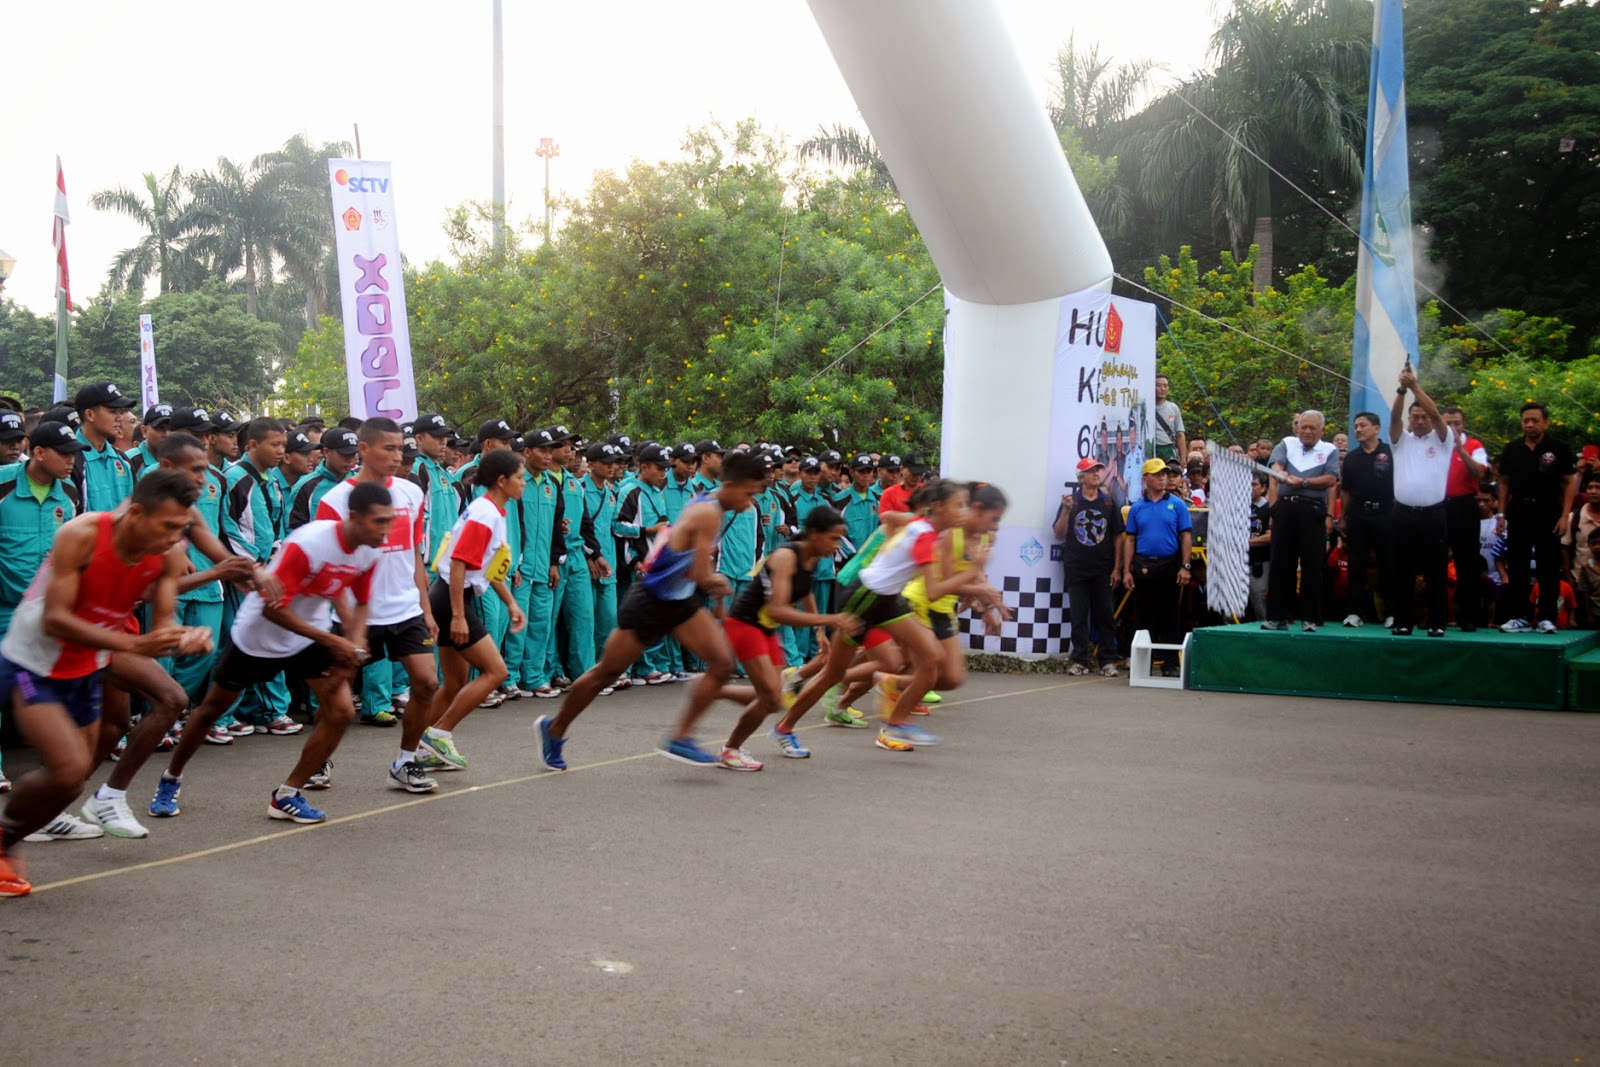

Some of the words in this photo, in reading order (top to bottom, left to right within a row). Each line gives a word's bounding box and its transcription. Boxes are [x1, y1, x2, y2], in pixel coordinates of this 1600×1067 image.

[349, 177, 389, 193] SCTV
[1120, 388, 1138, 409] TNI
[498, 559, 510, 575] 5
